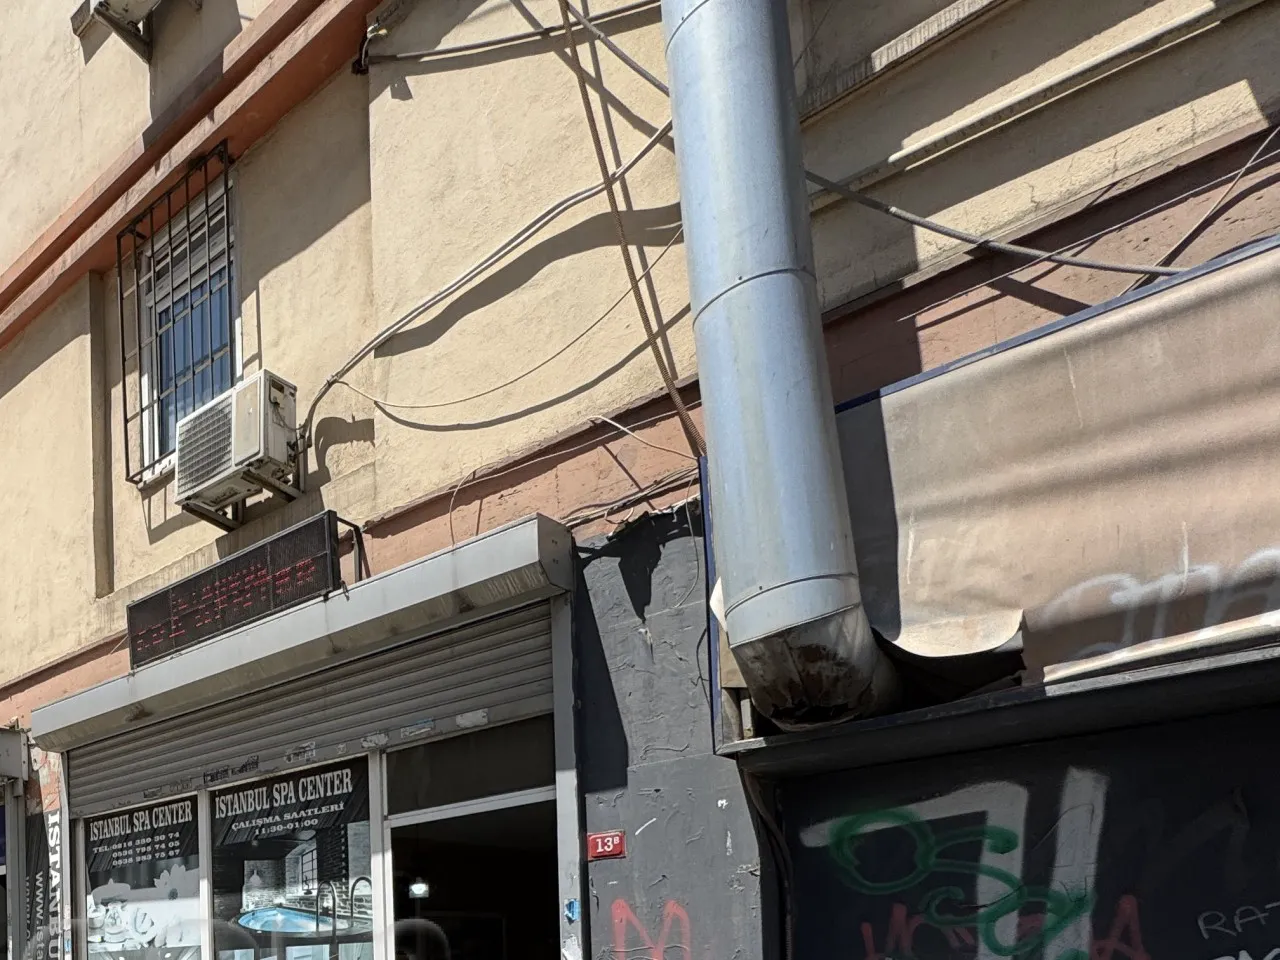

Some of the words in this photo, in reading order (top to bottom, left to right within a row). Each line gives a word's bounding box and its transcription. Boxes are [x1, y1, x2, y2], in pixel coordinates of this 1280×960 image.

[272, 781, 296, 807] SPA
[298, 768, 353, 802] CENTER
[132, 810, 151, 833] SPA
[152, 800, 192, 829] CENTER
[231, 816, 281, 832] ÇALIŞMA
[283, 800, 345, 820] SAATLERİ
